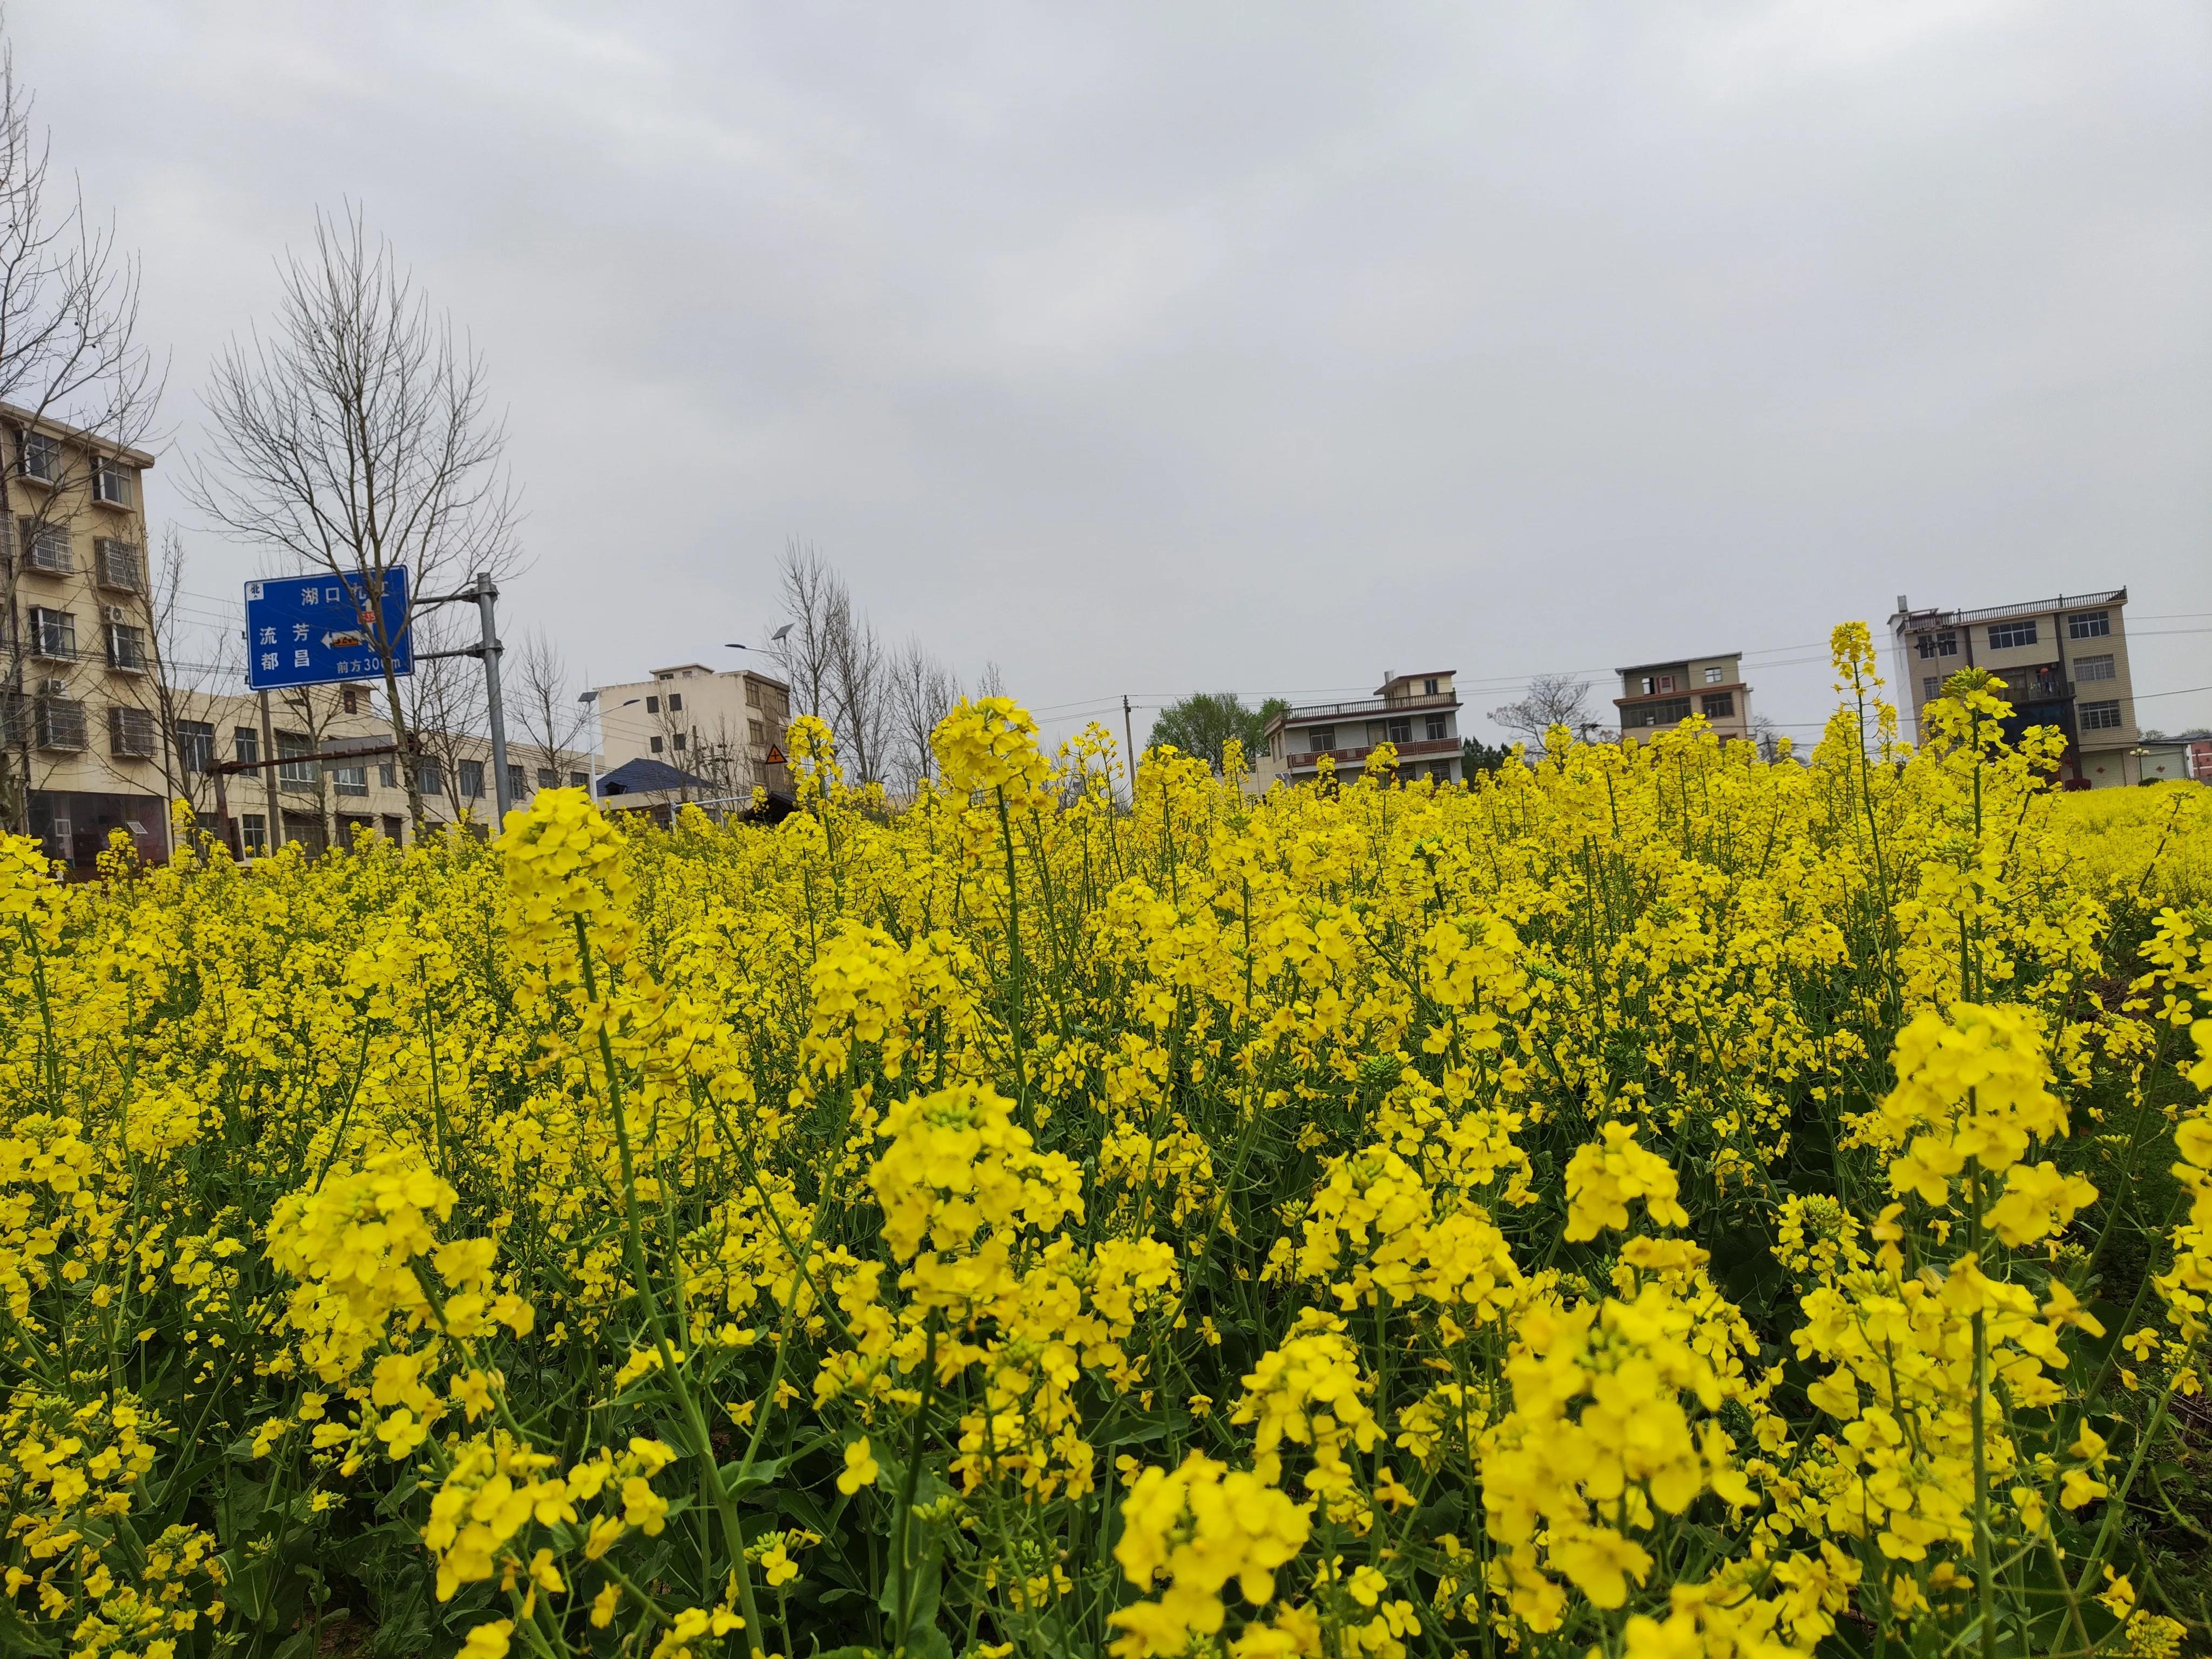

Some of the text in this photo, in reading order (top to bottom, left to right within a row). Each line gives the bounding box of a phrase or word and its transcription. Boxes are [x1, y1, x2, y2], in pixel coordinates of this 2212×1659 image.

[251, 583, 260, 594] 北
[301, 587, 340, 605] 湖口
[260, 623, 309, 645] 流芳
[261, 649, 309, 671] 都昌
